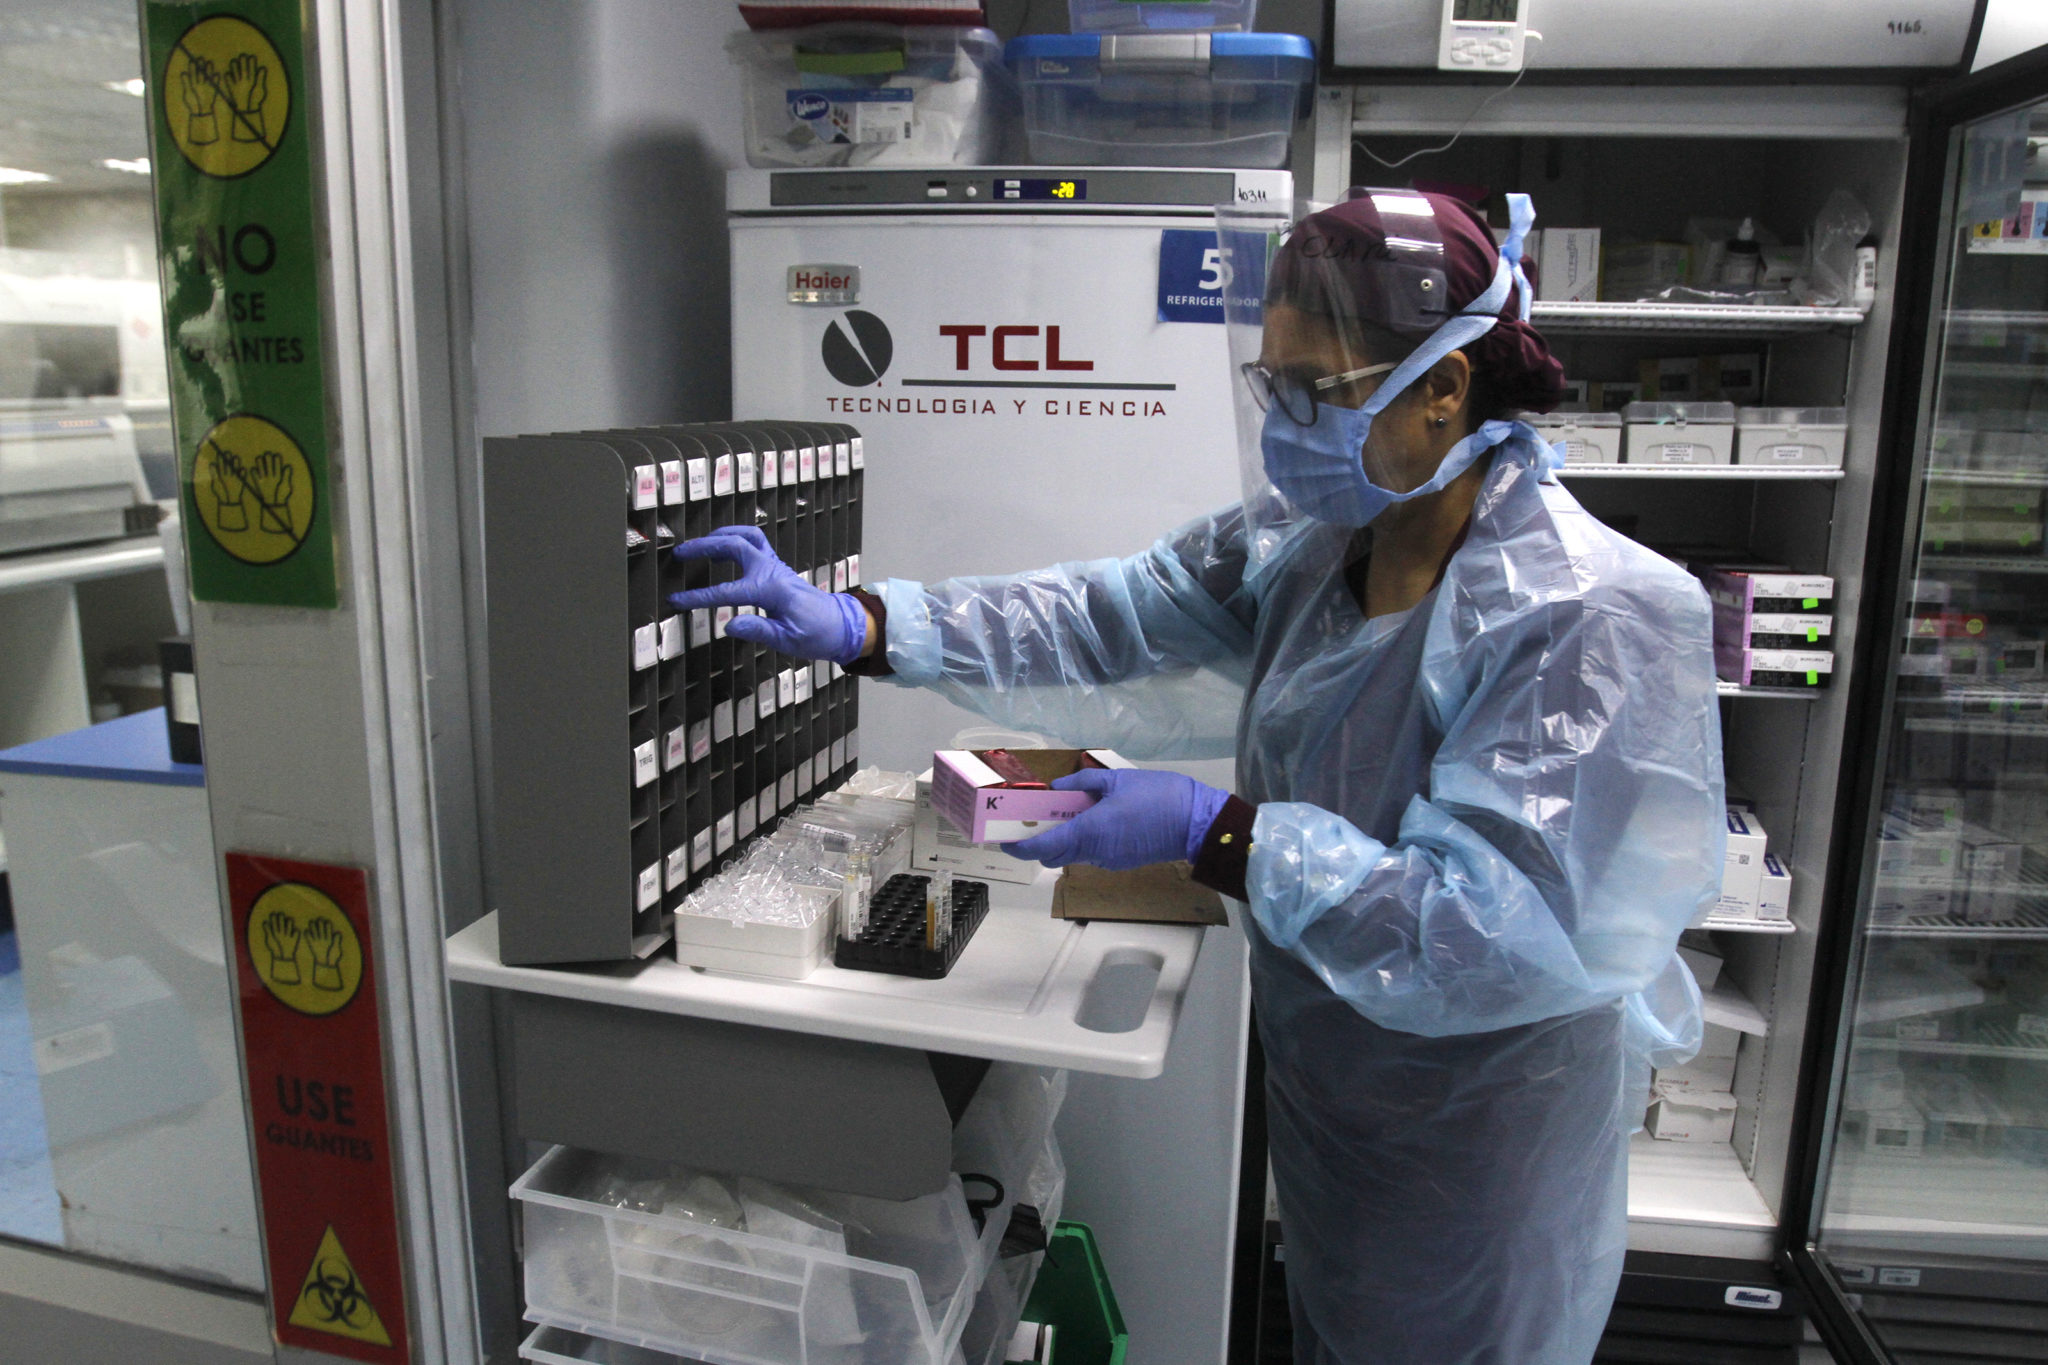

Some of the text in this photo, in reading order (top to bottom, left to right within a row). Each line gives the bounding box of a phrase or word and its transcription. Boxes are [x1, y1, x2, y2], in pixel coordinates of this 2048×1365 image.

[197, 223, 276, 275] NO
[1198, 248, 1234, 290] 5
[796, 271, 851, 289] Haier
[222, 291, 266, 323] SE
[1166, 295, 1260, 308] REFRIGERDOR
[939, 325, 1094, 371] TCL
[827, 397, 1167, 417] TECNOLOGIA Y CIENCIA
[276, 1074, 356, 1127] USE
[265, 1121, 374, 1162] GUANTES
